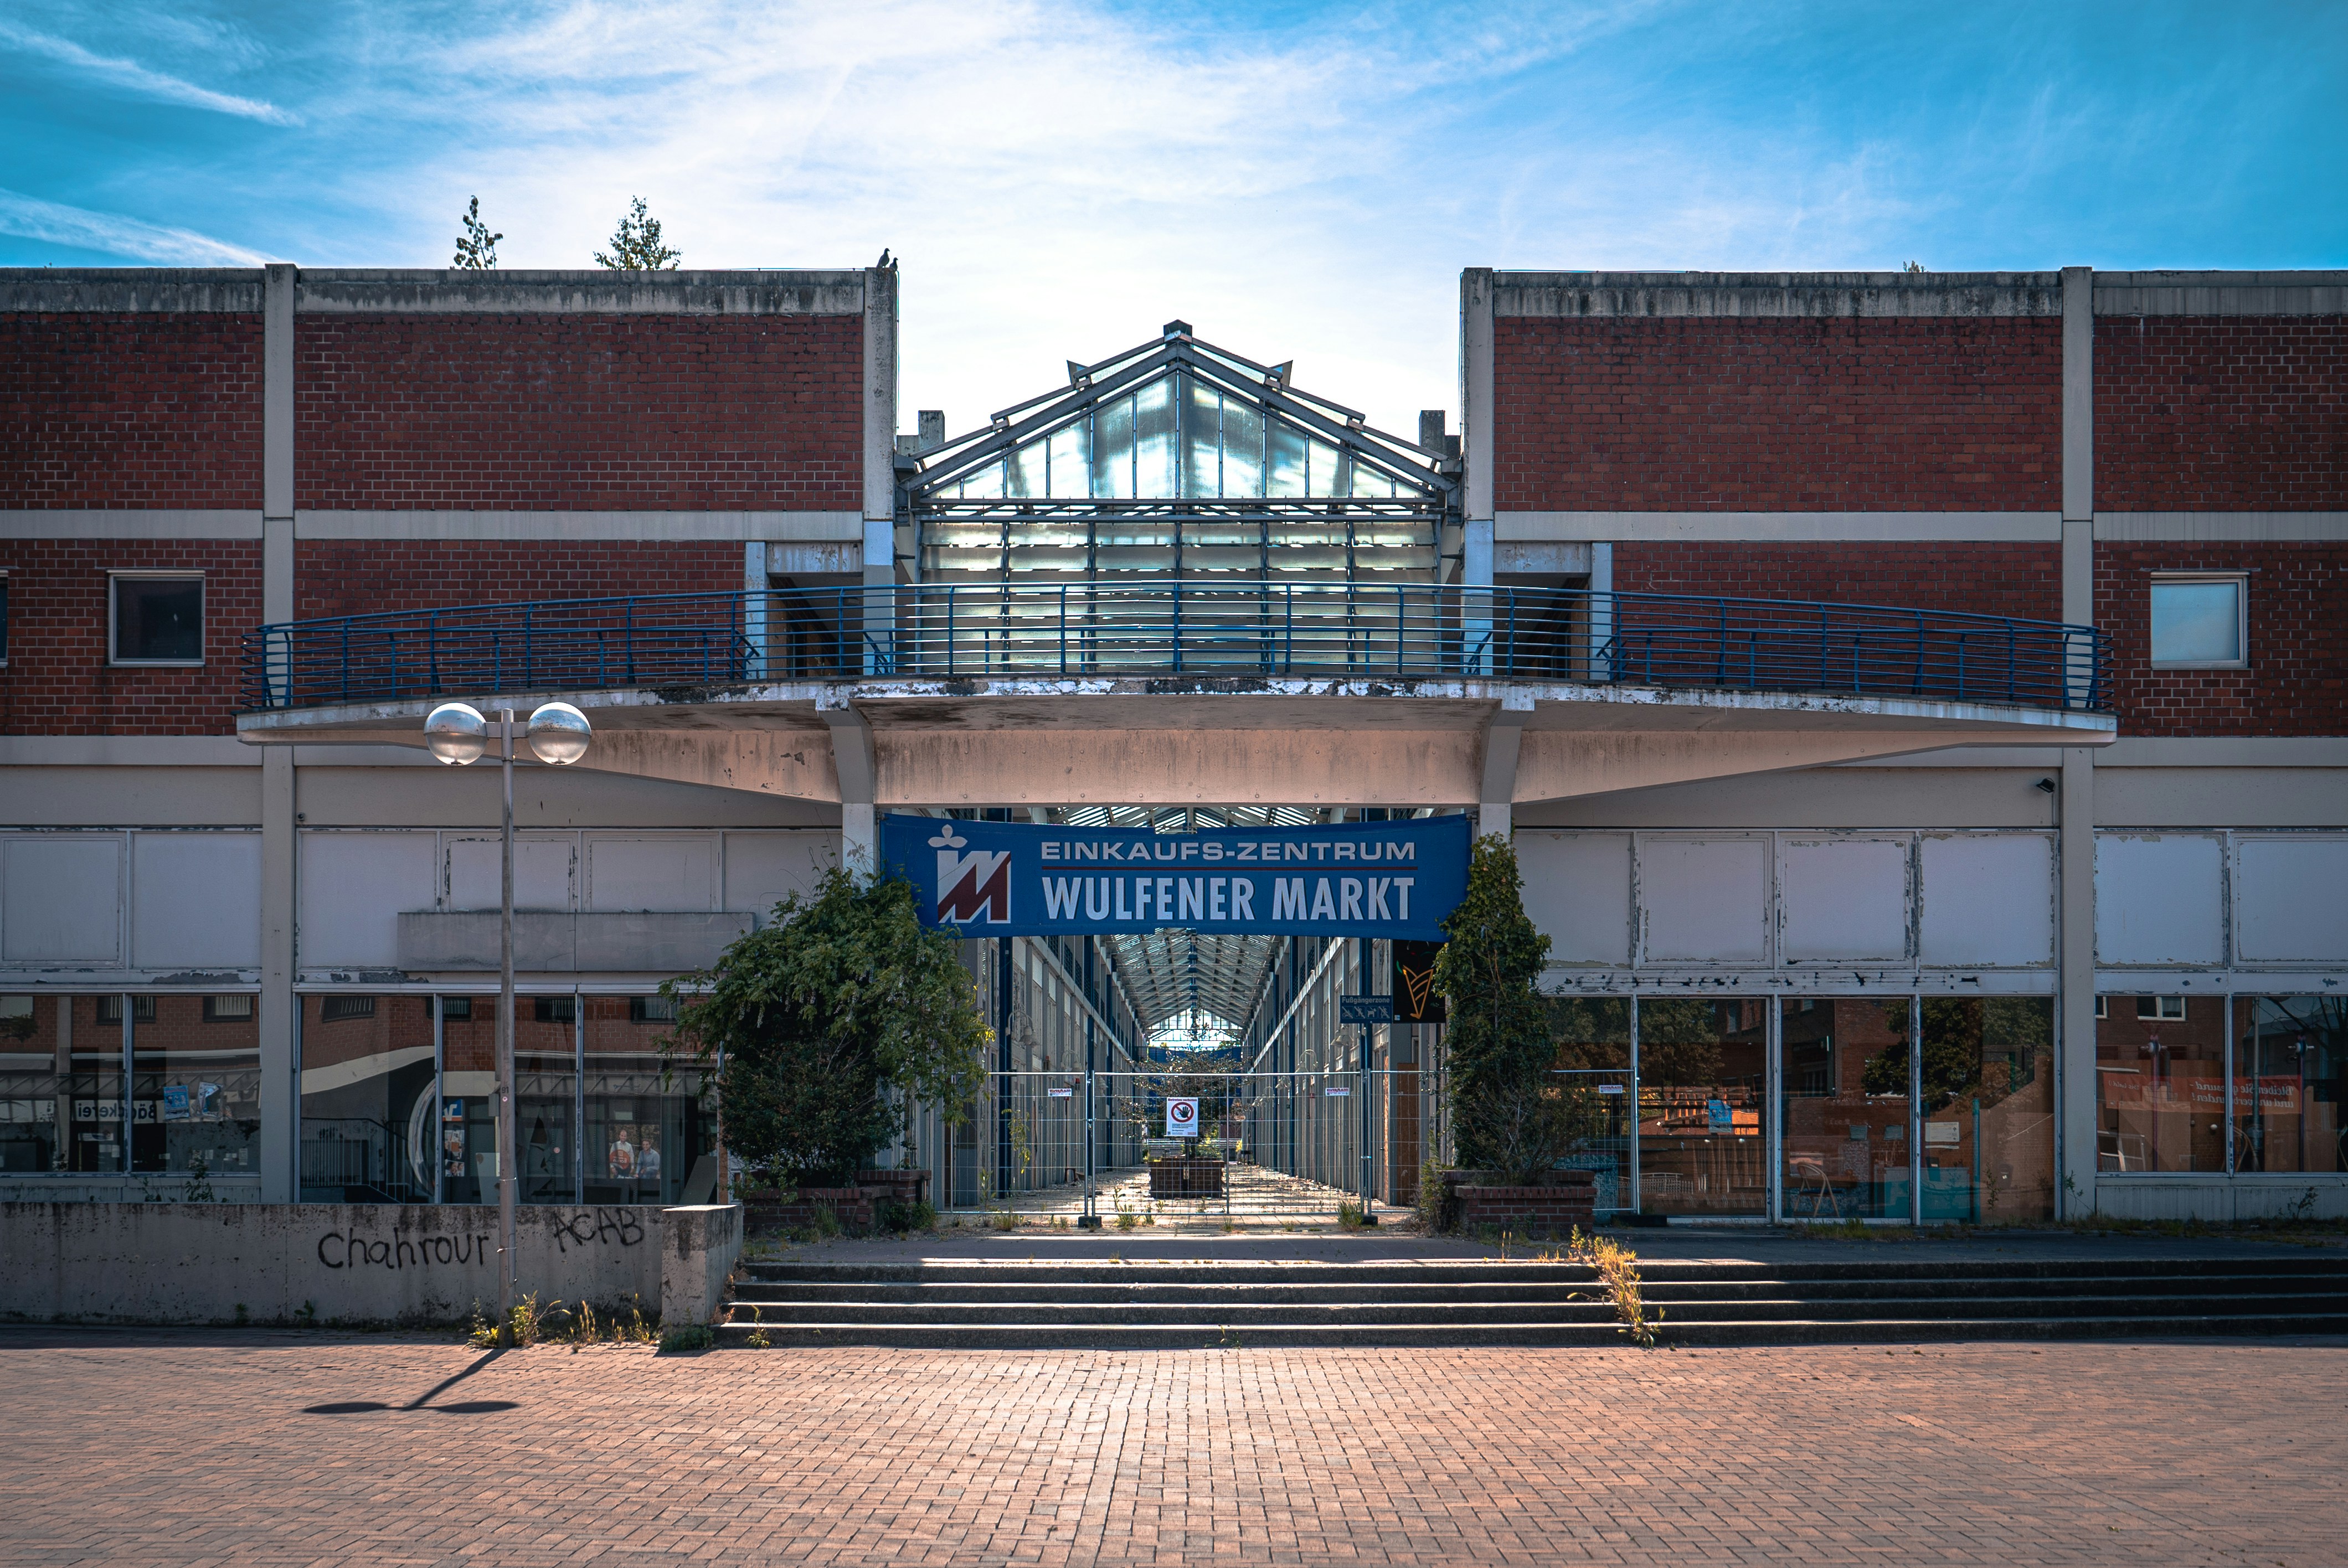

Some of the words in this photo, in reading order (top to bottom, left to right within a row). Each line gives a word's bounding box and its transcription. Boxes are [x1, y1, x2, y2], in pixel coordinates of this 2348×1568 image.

[1041, 841, 1416, 860] EINKAUFS-ZENTRUM
[1042, 876, 1253, 921] WULFENER
[1273, 876, 1415, 921] MARKT
[318, 1226, 489, 1270] Chahrour
[552, 1207, 645, 1252] ACAB
